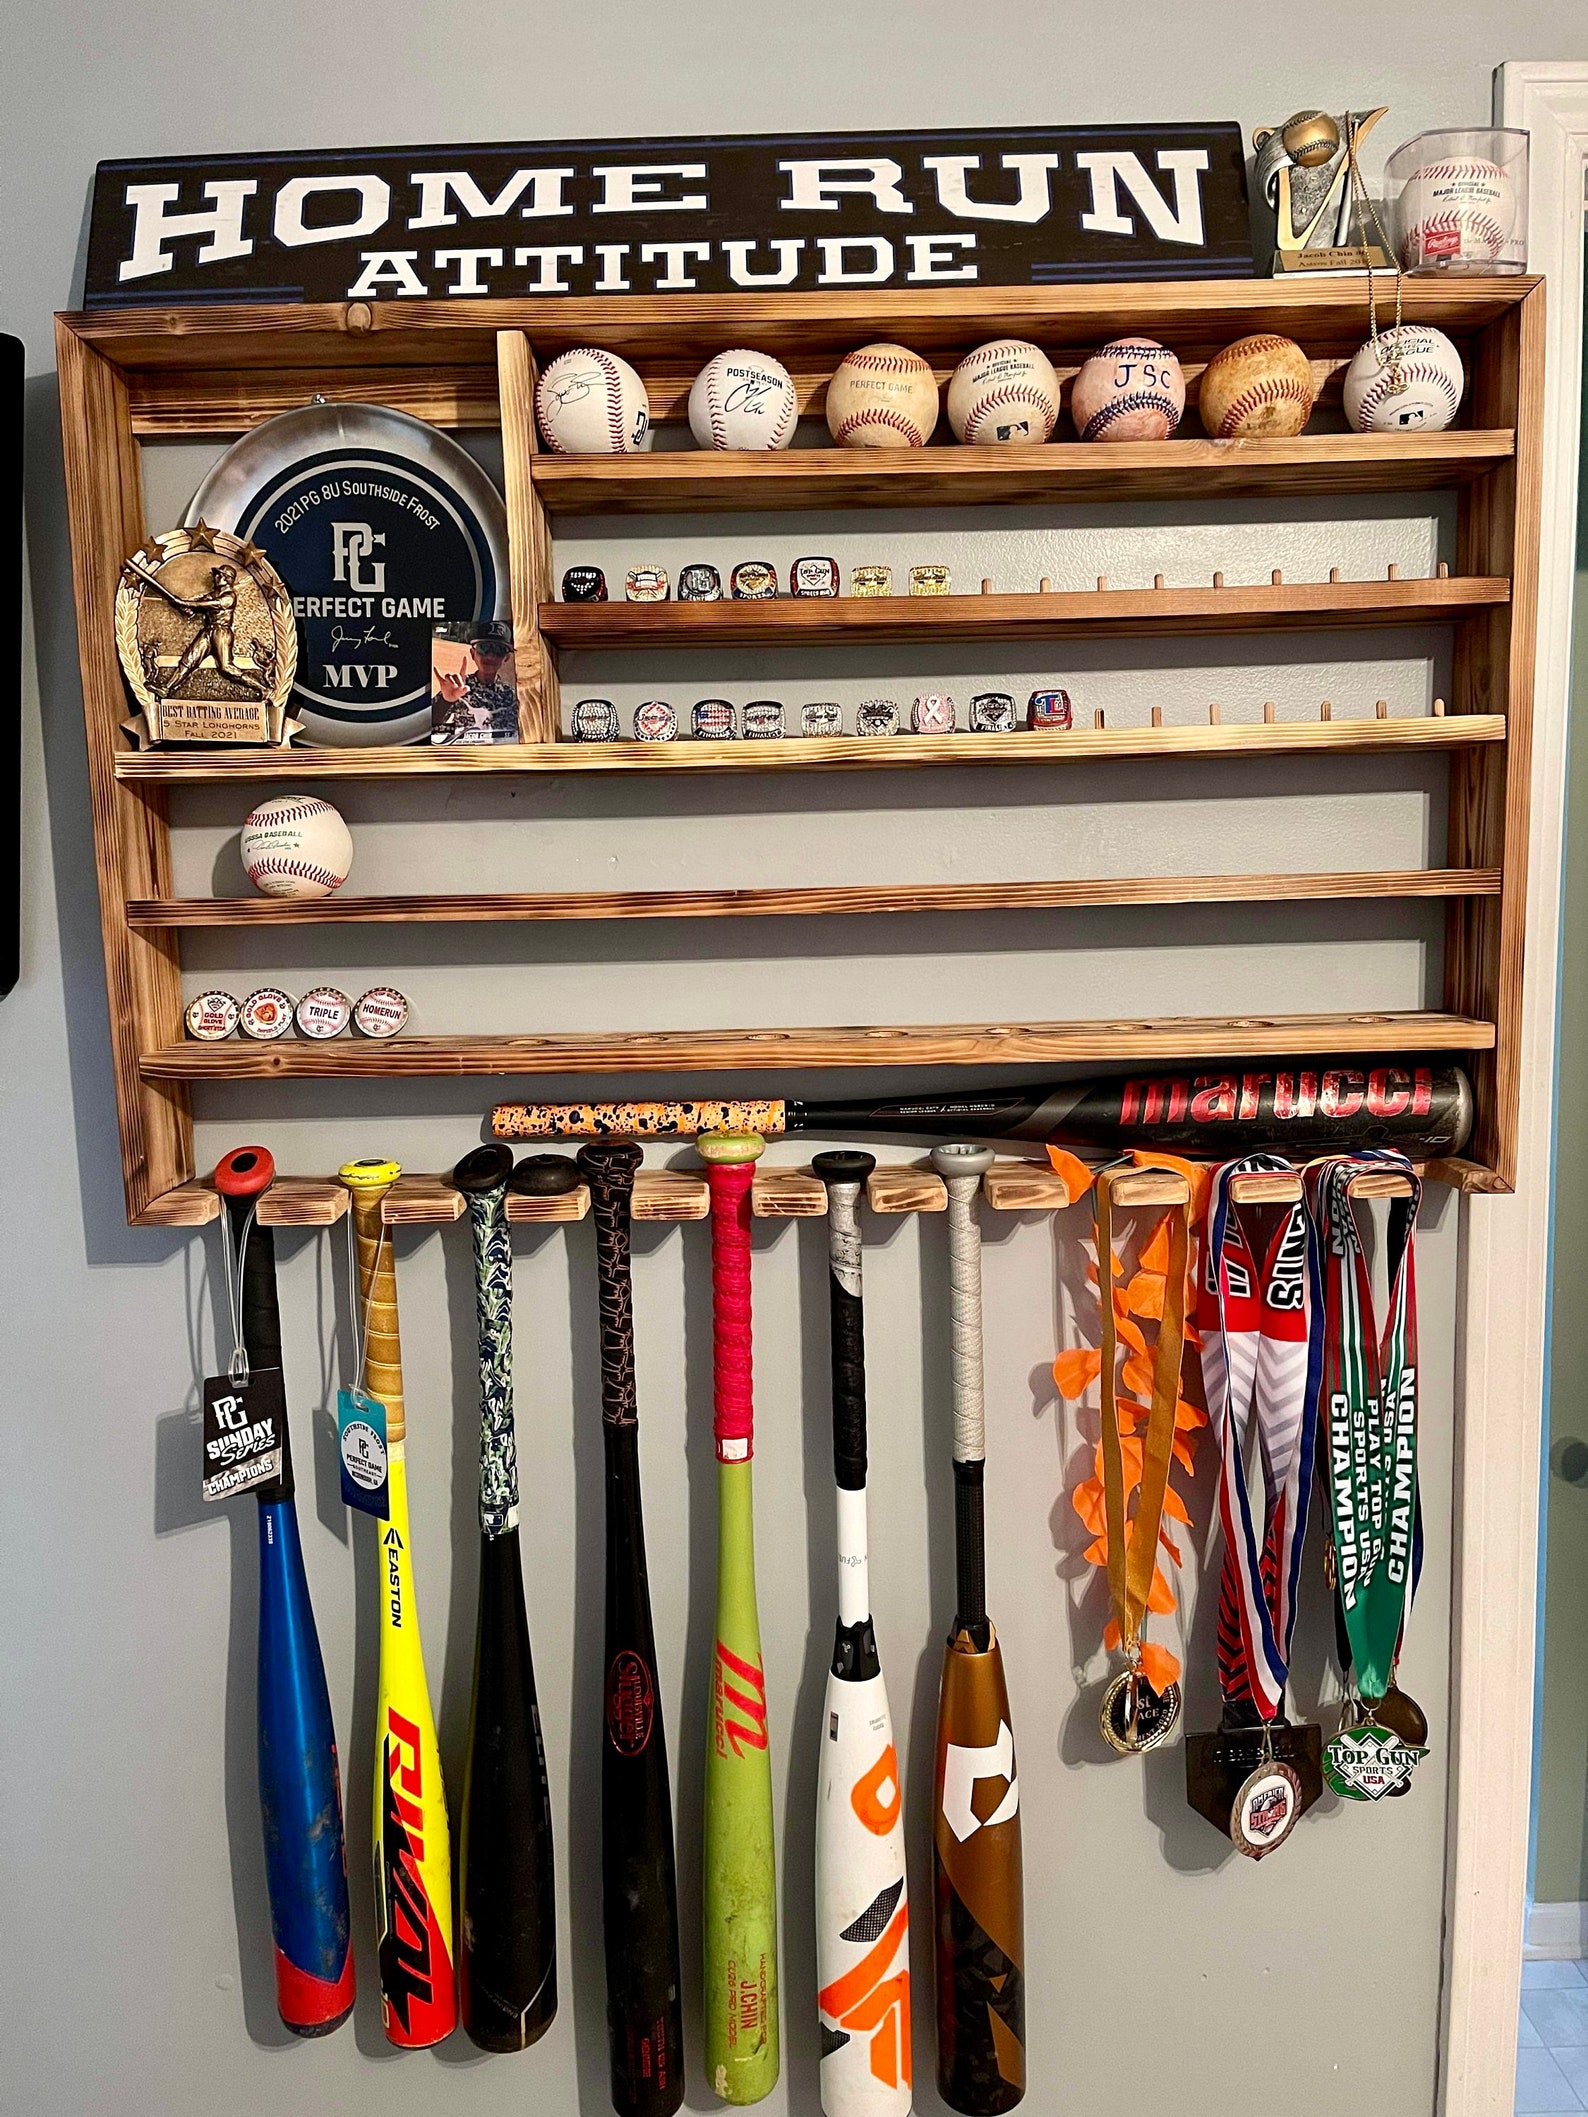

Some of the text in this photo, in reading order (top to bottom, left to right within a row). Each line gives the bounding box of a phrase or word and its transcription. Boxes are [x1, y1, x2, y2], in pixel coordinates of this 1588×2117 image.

[1433, 188, 1454, 197] MAJOR
[1476, 188, 1501, 198] BASEBALL
[116, 148, 1210, 284] HOME RUN
[346, 233, 979, 298] ATTITUDE
[1328, 250, 1353, 258] Chin
[727, 367, 783, 389] POSTSEASON
[850, 380, 913, 393] PERFECT GAME
[275, 502, 304, 534] 2021
[300, 490, 321, 511] PG
[321, 481, 341, 501] 8U
[293, 596, 446, 618] ERFECT GAME
[322, 664, 398, 688] MVP
[162, 705, 260, 720] BEST BATTING AVERAGE
[211, 731, 237, 739] 2021
[264, 830, 303, 838] BASEBALL
[246, 993, 282, 1019] GOLD GLOVE
[309, 1006, 340, 1020] TRIPLE
[362, 1003, 402, 1020] HOMERUN
[1119, 1066, 1433, 1125] marucci
[1384, 1390, 1397, 1444] USA
[206, 1417, 275, 1460] SUNDAY
[207, 1459, 273, 1496] CHAMPIONS
[346, 1453, 383, 1474] PERFECT GAME
[1387, 1367, 1415, 1585] CHAMPION
[1331, 1393, 1357, 1611] CHAMPION
[1353, 1410, 1371, 1582] SPORTS USA
[1363, 1398, 1383, 1588] PLAY TOP GUN
[388, 1547, 402, 1628] EASTON
[613, 1660, 640, 1748] Slugger
[633, 1680, 645, 1740] LOUISVILLE
[713, 1656, 728, 1760] marucci
[1352, 1766, 1394, 1775] SPORTS
[1362, 1775, 1385, 1785] USA
[728, 1989, 737, 2011] PRO
[759, 1953, 767, 2023] HANDCRAFTED
[729, 2013, 737, 2049] MODEL
